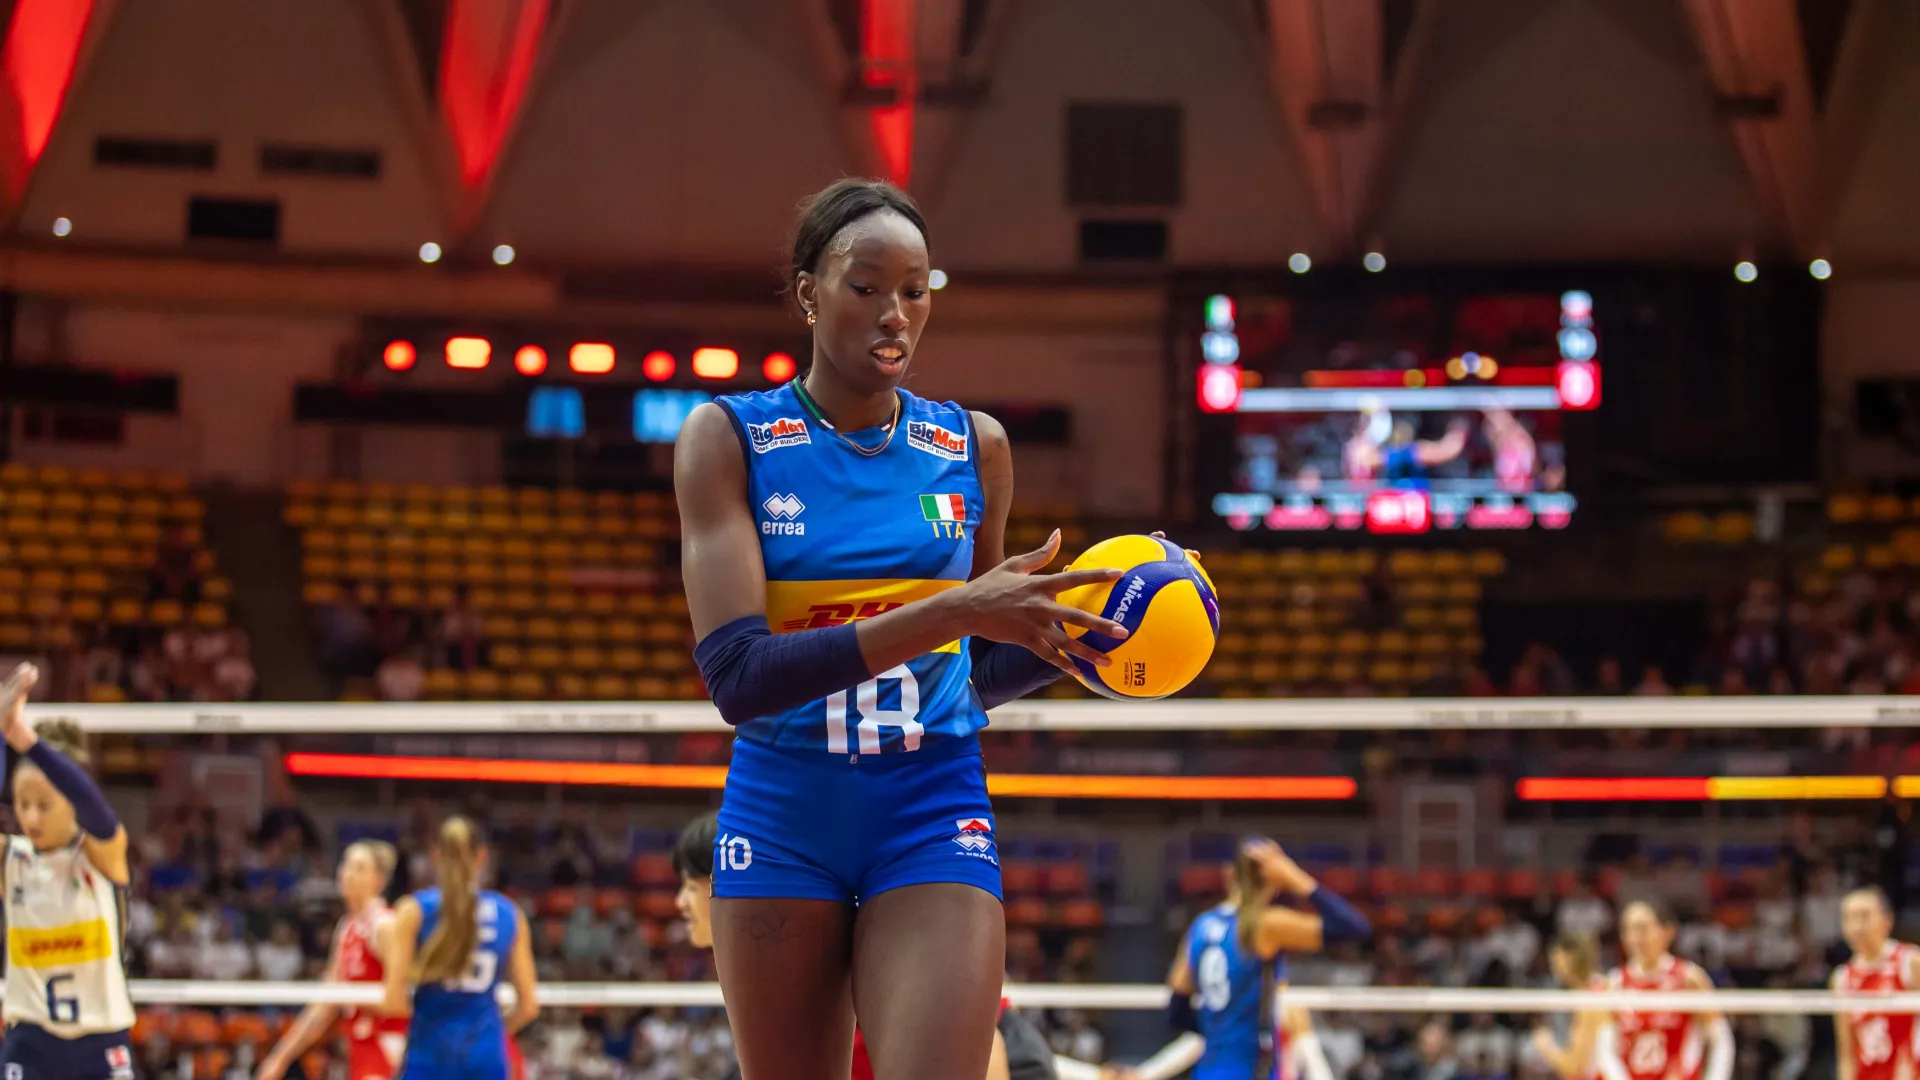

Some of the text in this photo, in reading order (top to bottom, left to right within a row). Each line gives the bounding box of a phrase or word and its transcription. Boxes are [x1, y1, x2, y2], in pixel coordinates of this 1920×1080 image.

[748, 419, 806, 444] BigMat
[770, 440, 779, 448] OF
[909, 422, 966, 451] BigMat
[908, 438, 926, 449] HOME
[935, 449, 965, 460] BUILDERS
[931, 521, 967, 540] ITA
[825, 663, 925, 755] 18
[46, 972, 80, 1025] 6
